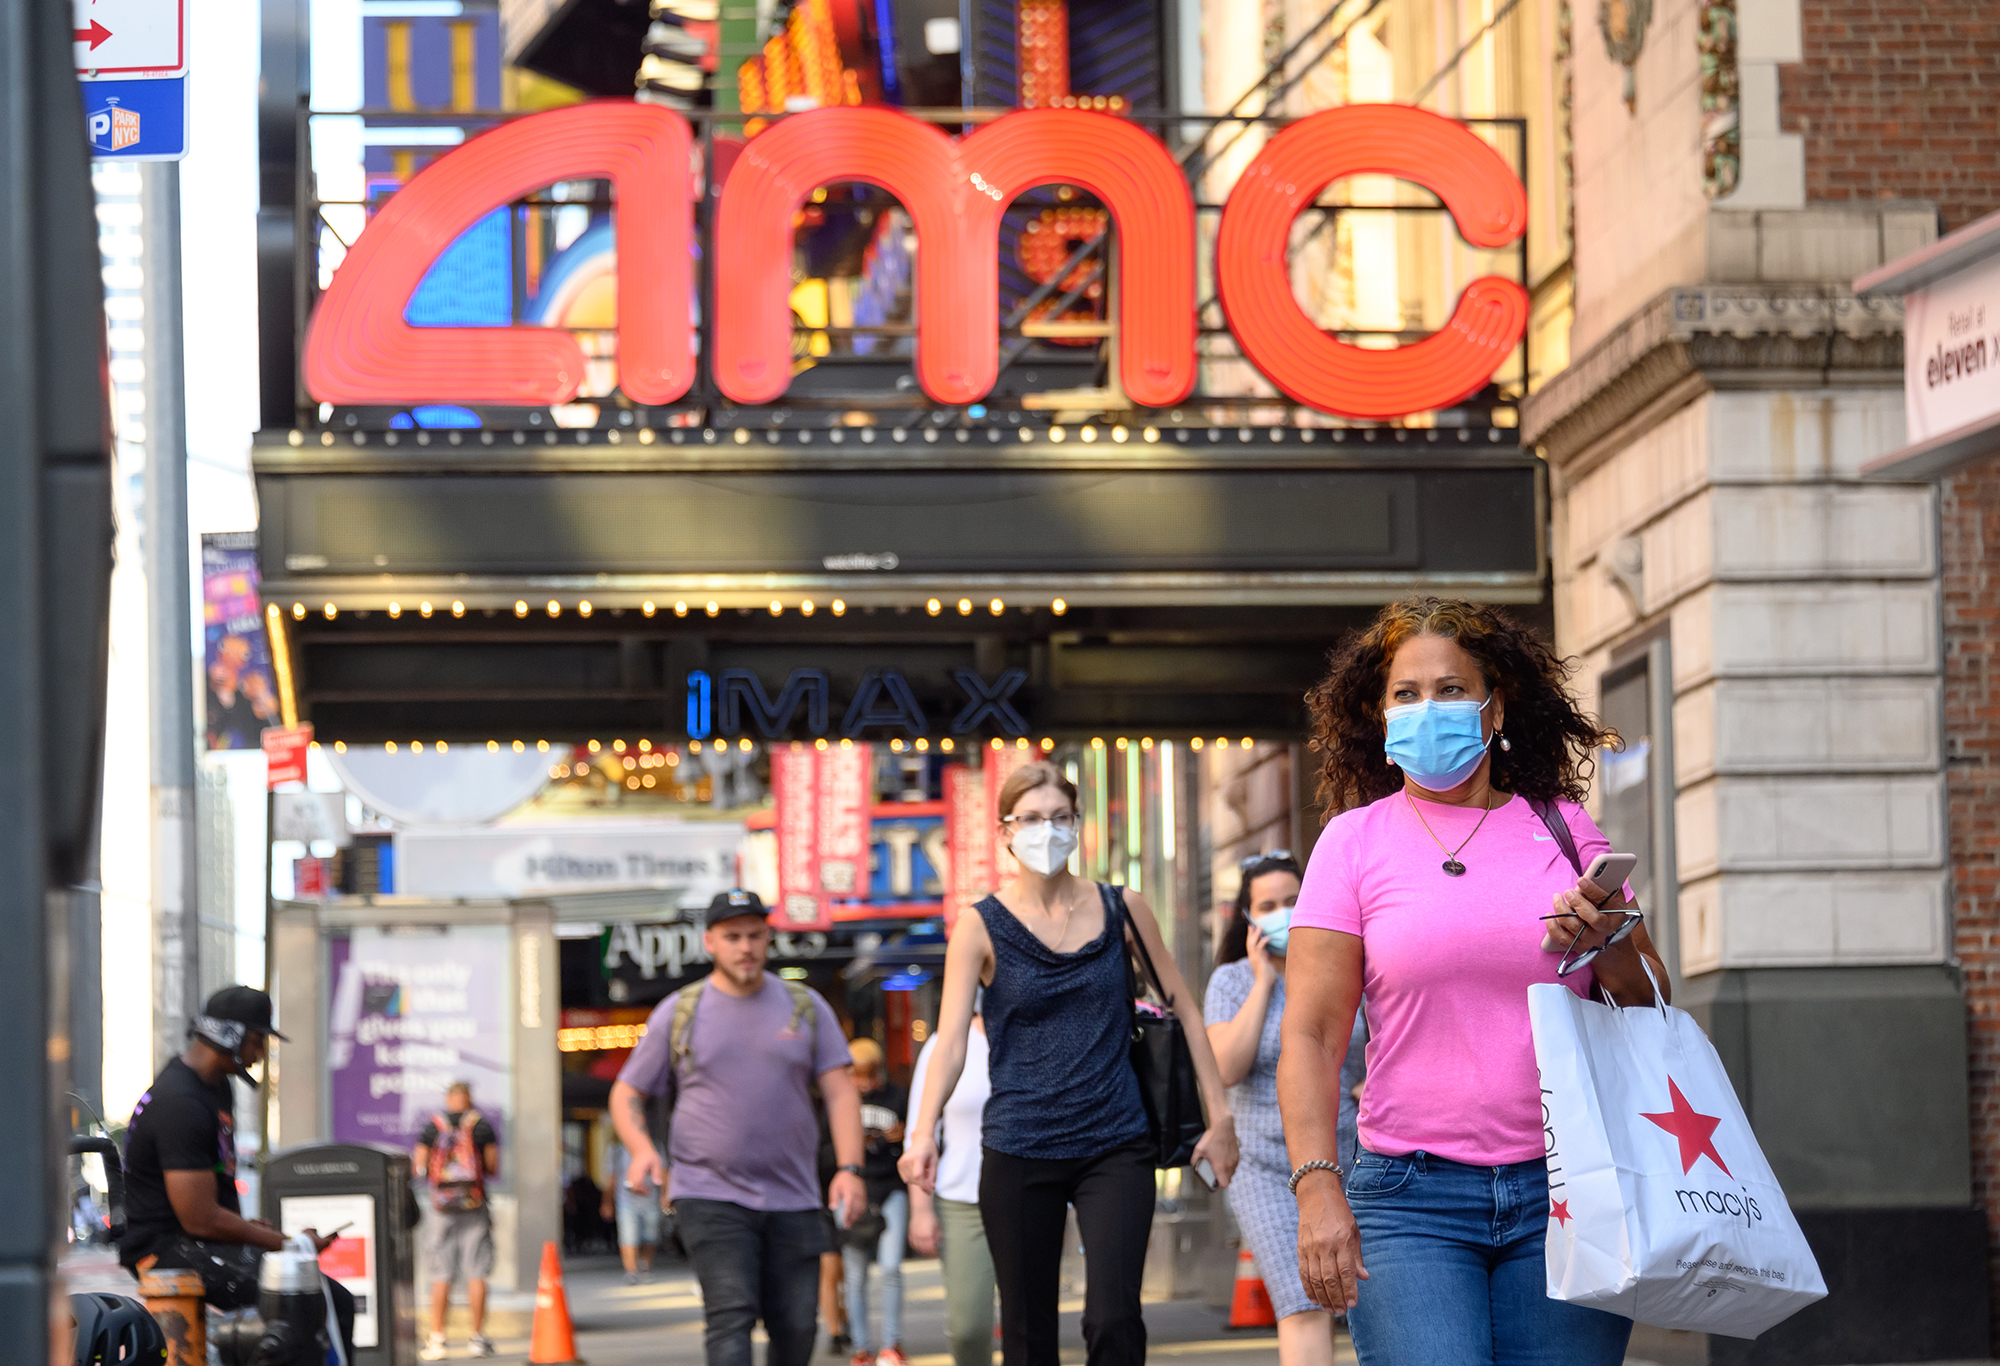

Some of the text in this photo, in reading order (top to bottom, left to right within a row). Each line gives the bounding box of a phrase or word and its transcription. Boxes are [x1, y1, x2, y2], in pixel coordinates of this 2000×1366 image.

[89, 113, 110, 144] P
[114, 111, 138, 127] PARK
[114, 127, 138, 147] NYC
[305, 103, 1528, 418] amc
[1927, 339, 1986, 388] eleven
[1719, 1262, 1734, 1271] and
[1733, 1263, 1759, 1277] recycle
[1760, 1268, 1771, 1279] this
